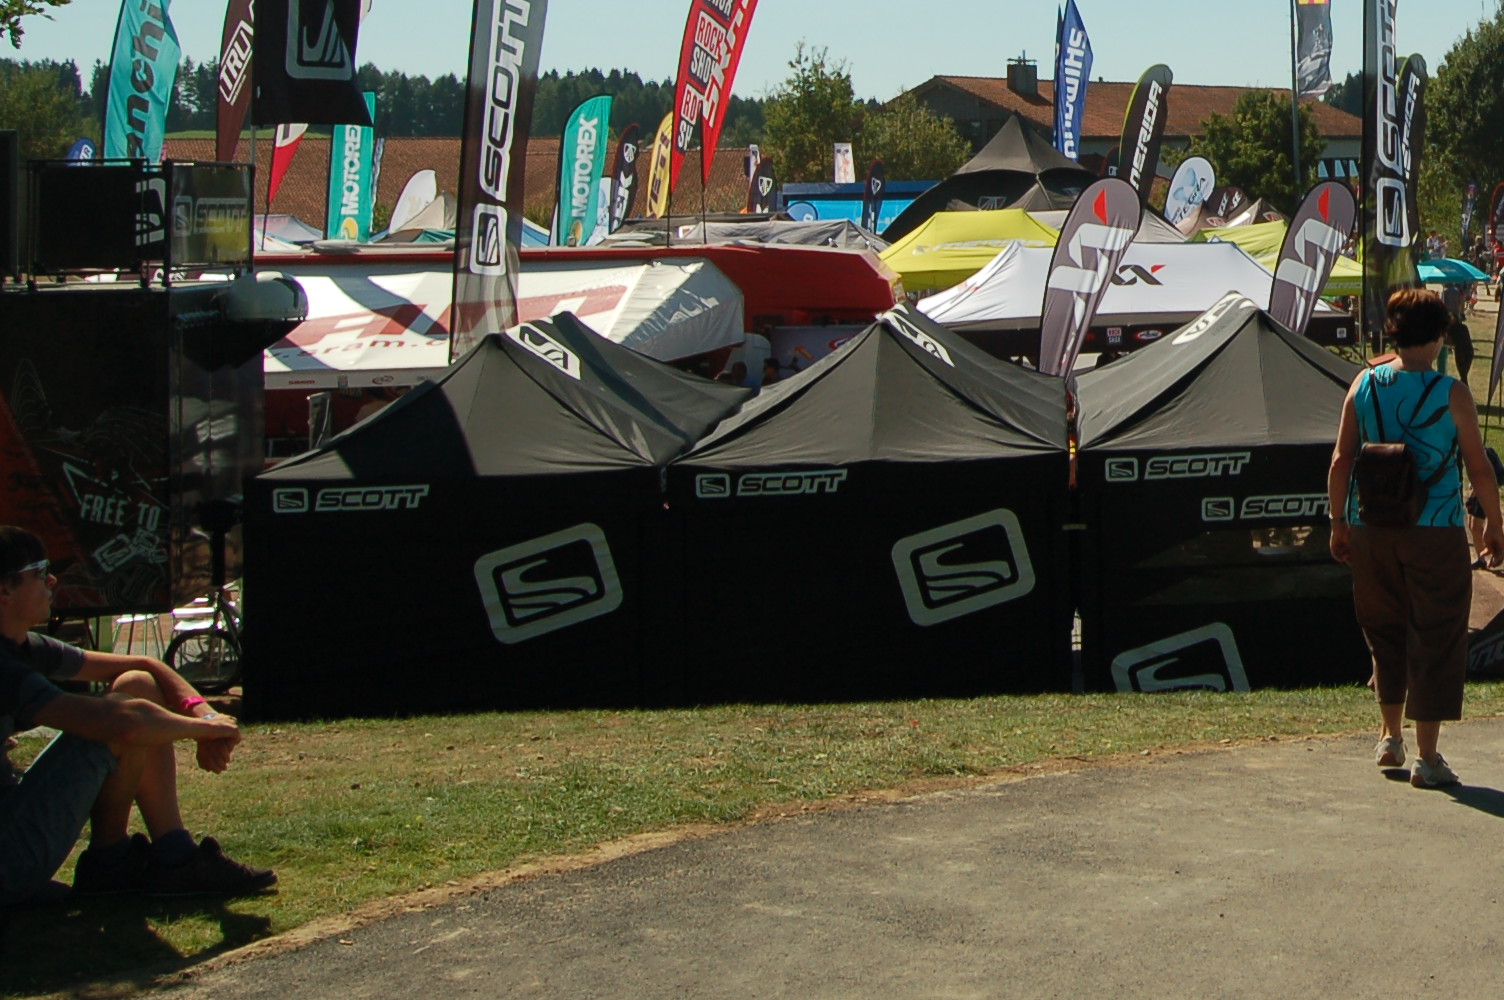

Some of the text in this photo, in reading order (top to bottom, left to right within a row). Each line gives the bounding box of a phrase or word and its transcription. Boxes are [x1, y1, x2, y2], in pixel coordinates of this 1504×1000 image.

[690, 47, 717, 84] SHO
[341, 125, 361, 216] MOTORE
[571, 117, 598, 217] MOTOREX
[736, 469, 848, 496] SCOTT
[1144, 451, 1251, 479] SCOTT
[81, 494, 161, 531] FREE TO
[315, 484, 430, 511] SCOTT
